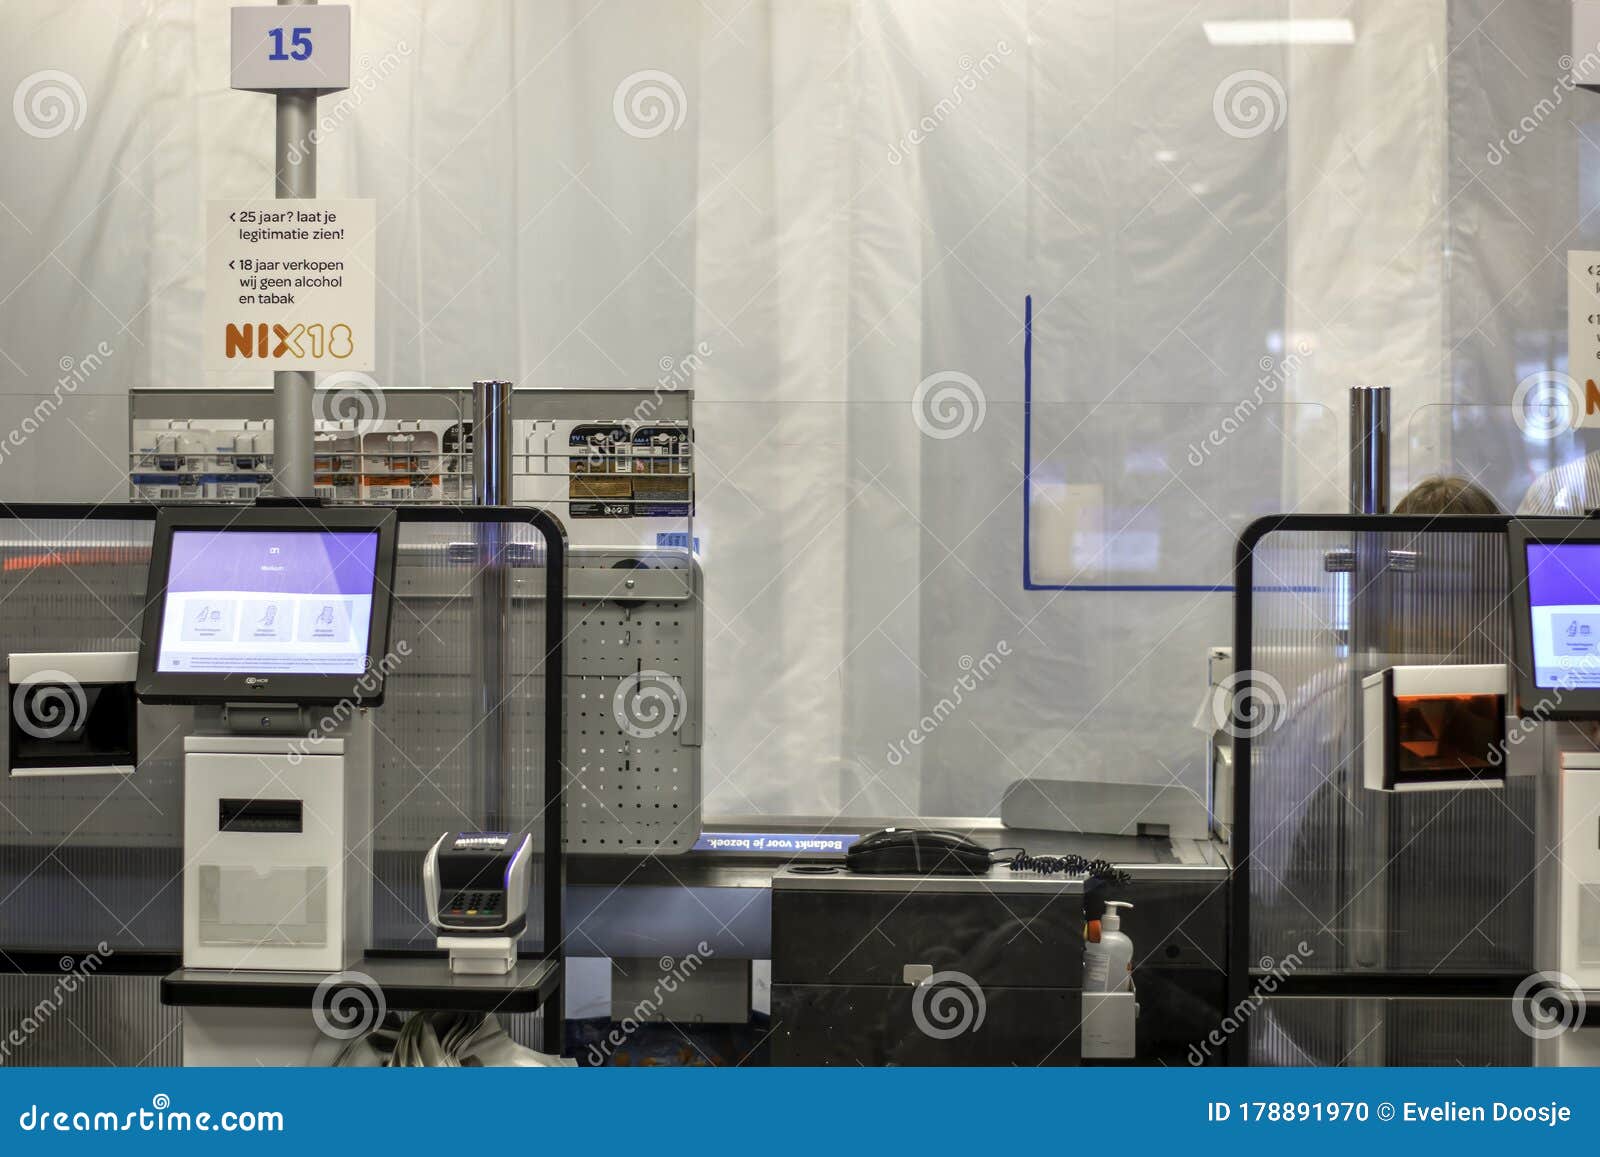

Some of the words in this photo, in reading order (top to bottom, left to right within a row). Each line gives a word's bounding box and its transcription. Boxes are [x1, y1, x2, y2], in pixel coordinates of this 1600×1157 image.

[269, 28, 313, 61] 15
[240, 211, 257, 223] 25
[258, 211, 294, 225] jaar?
[297, 211, 322, 223] laat
[324, 211, 337, 225] je
[239, 228, 309, 242] legitimatie
[313, 228, 344, 240] zien!
[240, 259, 253, 271] 18
[254, 259, 280, 273] jaar
[283, 259, 344, 273] verkopen
[240, 276, 257, 290] wij
[260, 278, 292, 290] geen
[295, 276, 342, 288] alcohol
[239, 295, 255, 305] en
[258, 293, 295, 305] tabak
[226, 323, 353, 359] NIX18
[706, 838, 750, 849] bezoek.
[753, 838, 766, 849] je
[766, 838, 793, 849] voor
[795, 839, 843, 850] Bedankt
